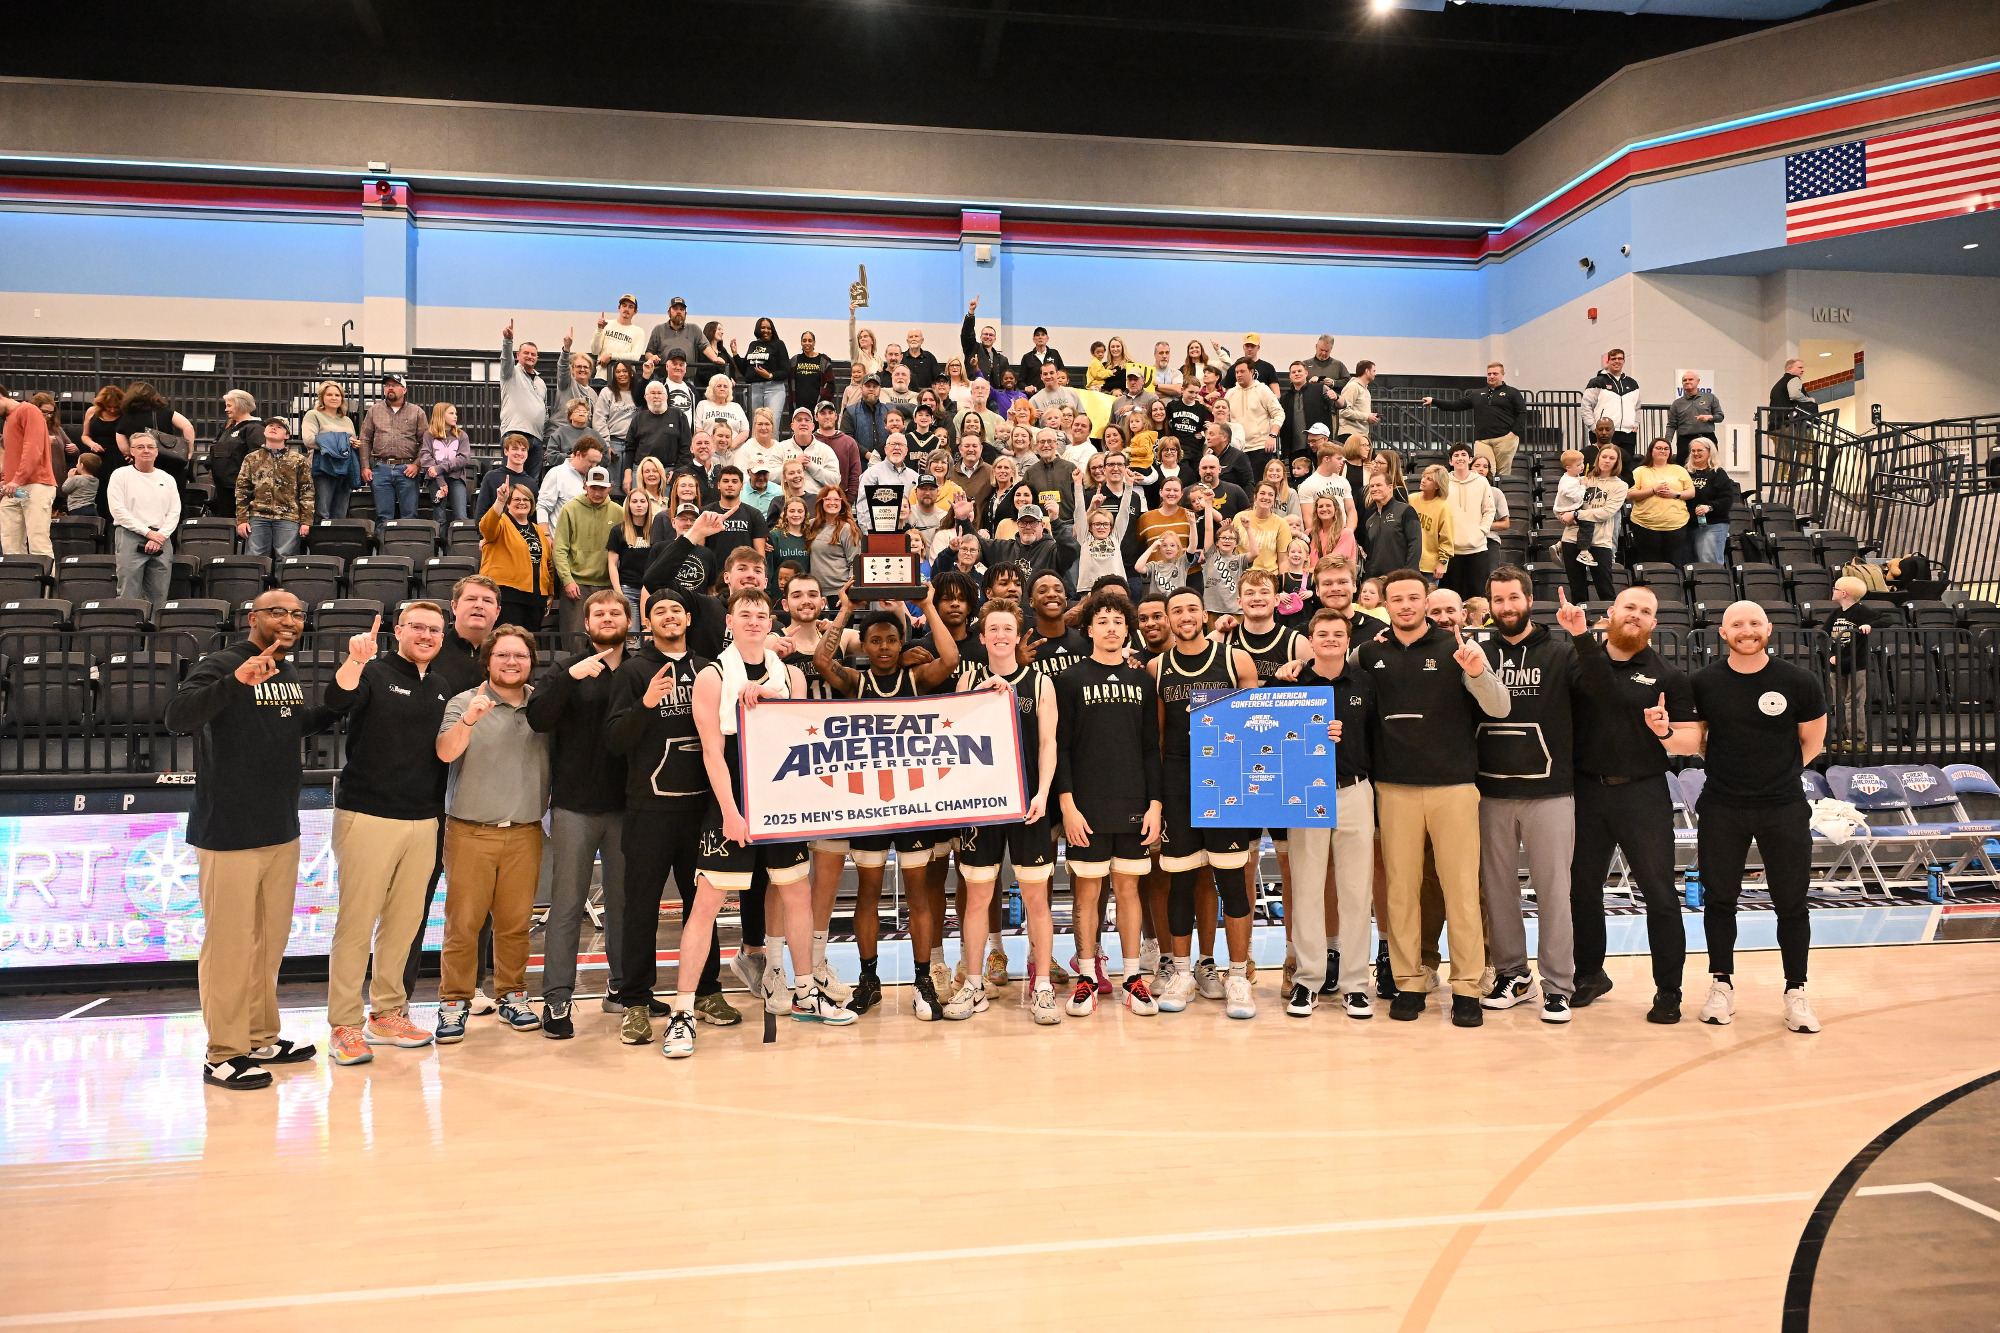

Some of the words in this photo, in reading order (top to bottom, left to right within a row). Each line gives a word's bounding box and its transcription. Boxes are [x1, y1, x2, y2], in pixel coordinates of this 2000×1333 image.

[1812, 307, 1852, 323] MEN
[1083, 684, 1144, 700] HARDING
[1272, 692, 1307, 700] AMERICAN
[1231, 700, 1273, 708] CONFERENCE
[1274, 699, 1328, 707] CHAMPIONSHIP
[824, 713, 939, 739] GREAT
[771, 734, 994, 783] AMERICAN
[814, 757, 956, 775] CONFERENCE
[156, 774, 180, 784] ACE
[1951, 770, 1988, 782] SOUTHSIDE
[763, 813, 797, 826] 2025
[801, 810, 844, 823] MEN'S
[847, 802, 932, 820] BASKETBALL
[935, 797, 1008, 812] CHAMPION
